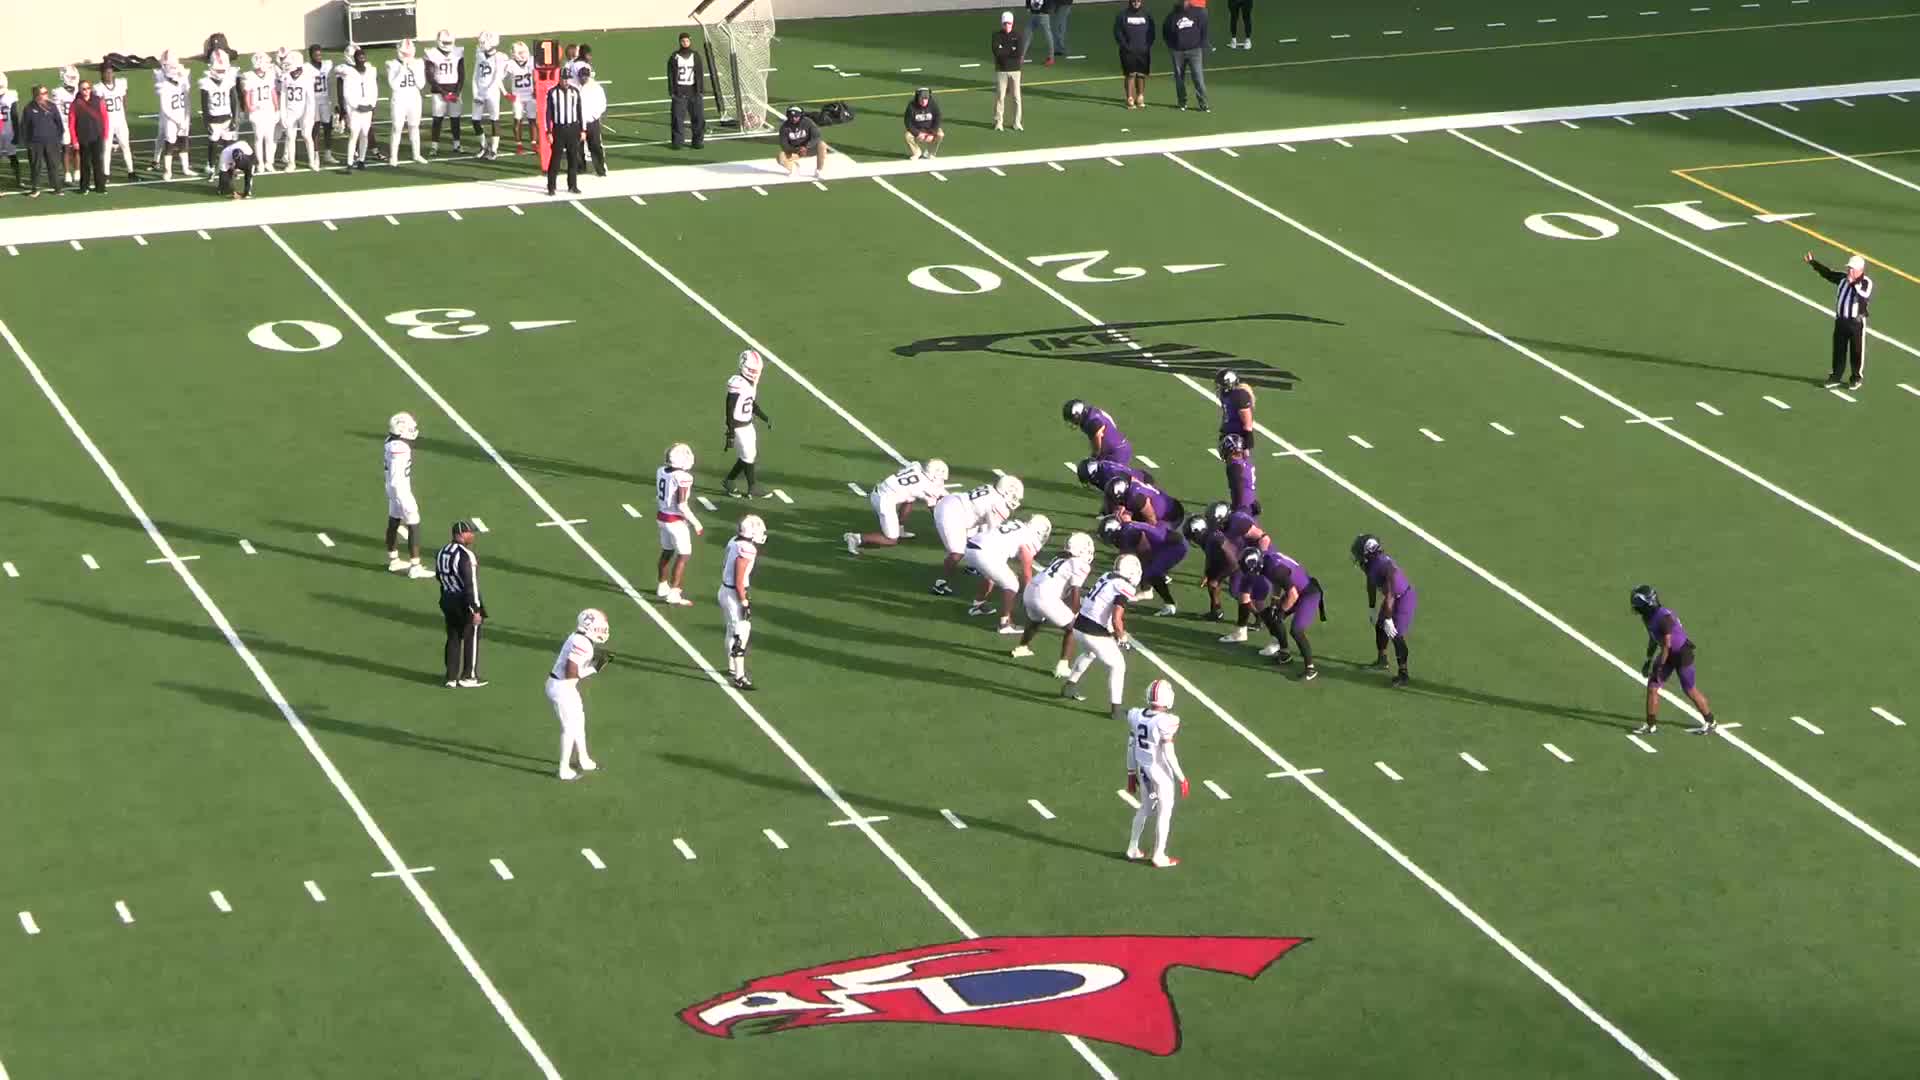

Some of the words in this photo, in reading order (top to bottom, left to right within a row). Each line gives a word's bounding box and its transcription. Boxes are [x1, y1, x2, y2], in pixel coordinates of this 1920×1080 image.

[541, 41, 552, 65] 1
[514, 73, 532, 88] 23
[678, 66, 695, 82] 27
[212, 91, 227, 107] 31
[287, 86, 303, 102] 33
[105, 96, 122, 112] 20
[907, 250, 1147, 295] 20
[247, 308, 491, 352] 30
[895, 468, 920, 486] 18
[1137, 723, 1149, 750] 2
